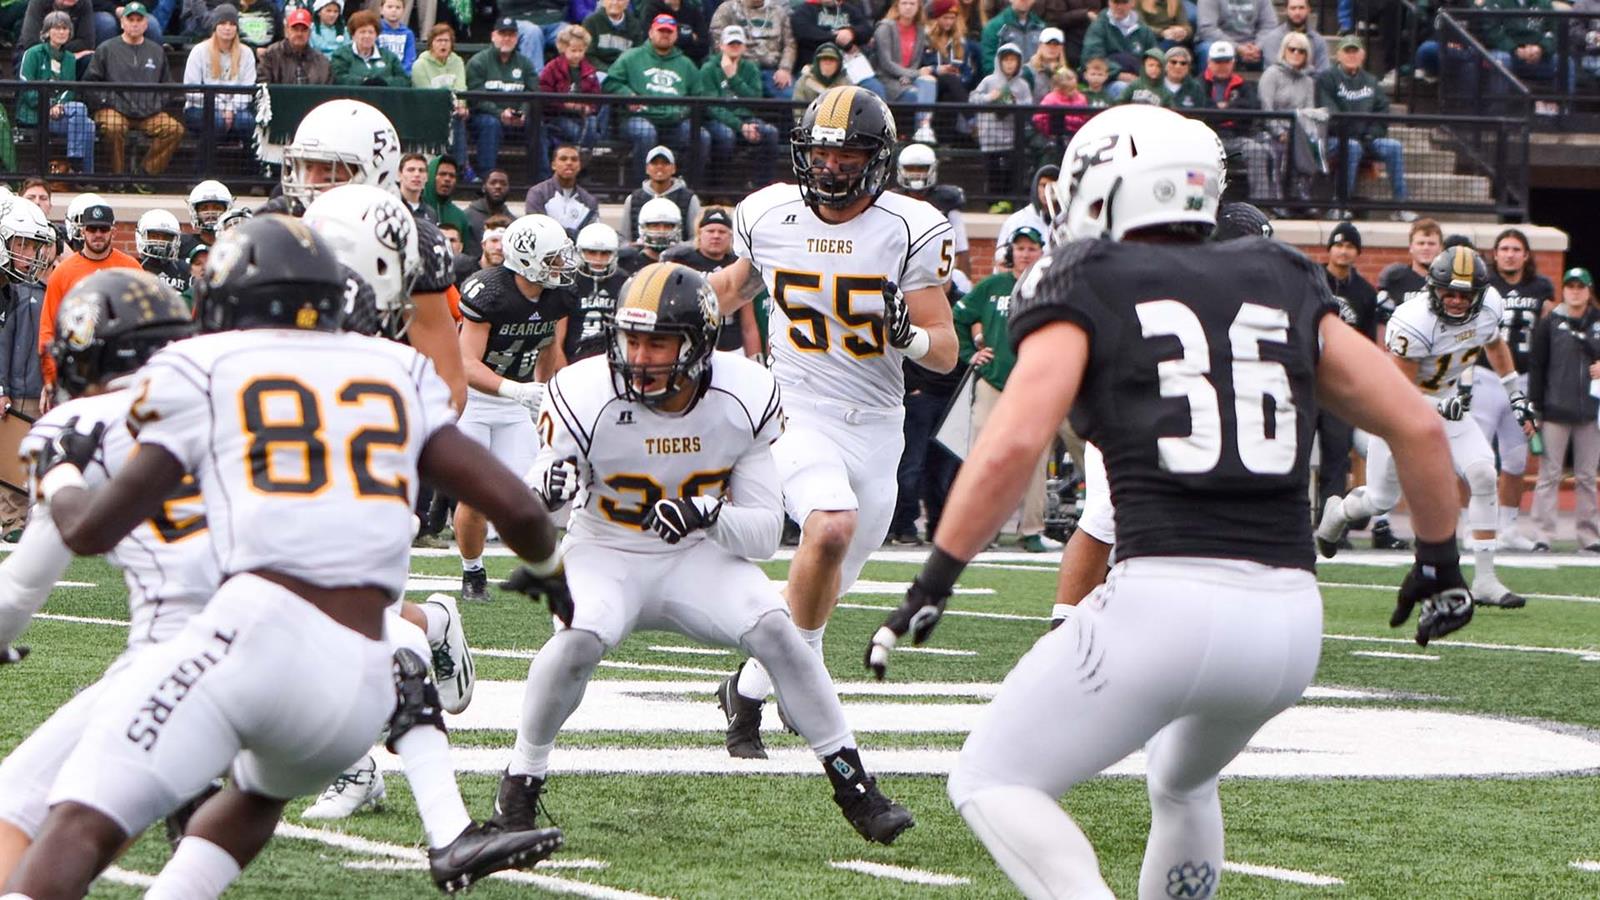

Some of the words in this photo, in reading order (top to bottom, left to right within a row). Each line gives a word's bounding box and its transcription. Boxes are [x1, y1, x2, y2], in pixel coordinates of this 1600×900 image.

[807, 238, 853, 255] TIGERS
[463, 279, 485, 299] 46
[580, 296, 616, 311] BEARCA
[772, 268, 888, 360] 55
[1134, 298, 1299, 476] 36
[238, 374, 413, 506] 82
[645, 437, 701, 455] TIGERS
[126, 628, 239, 752] TIGERS
